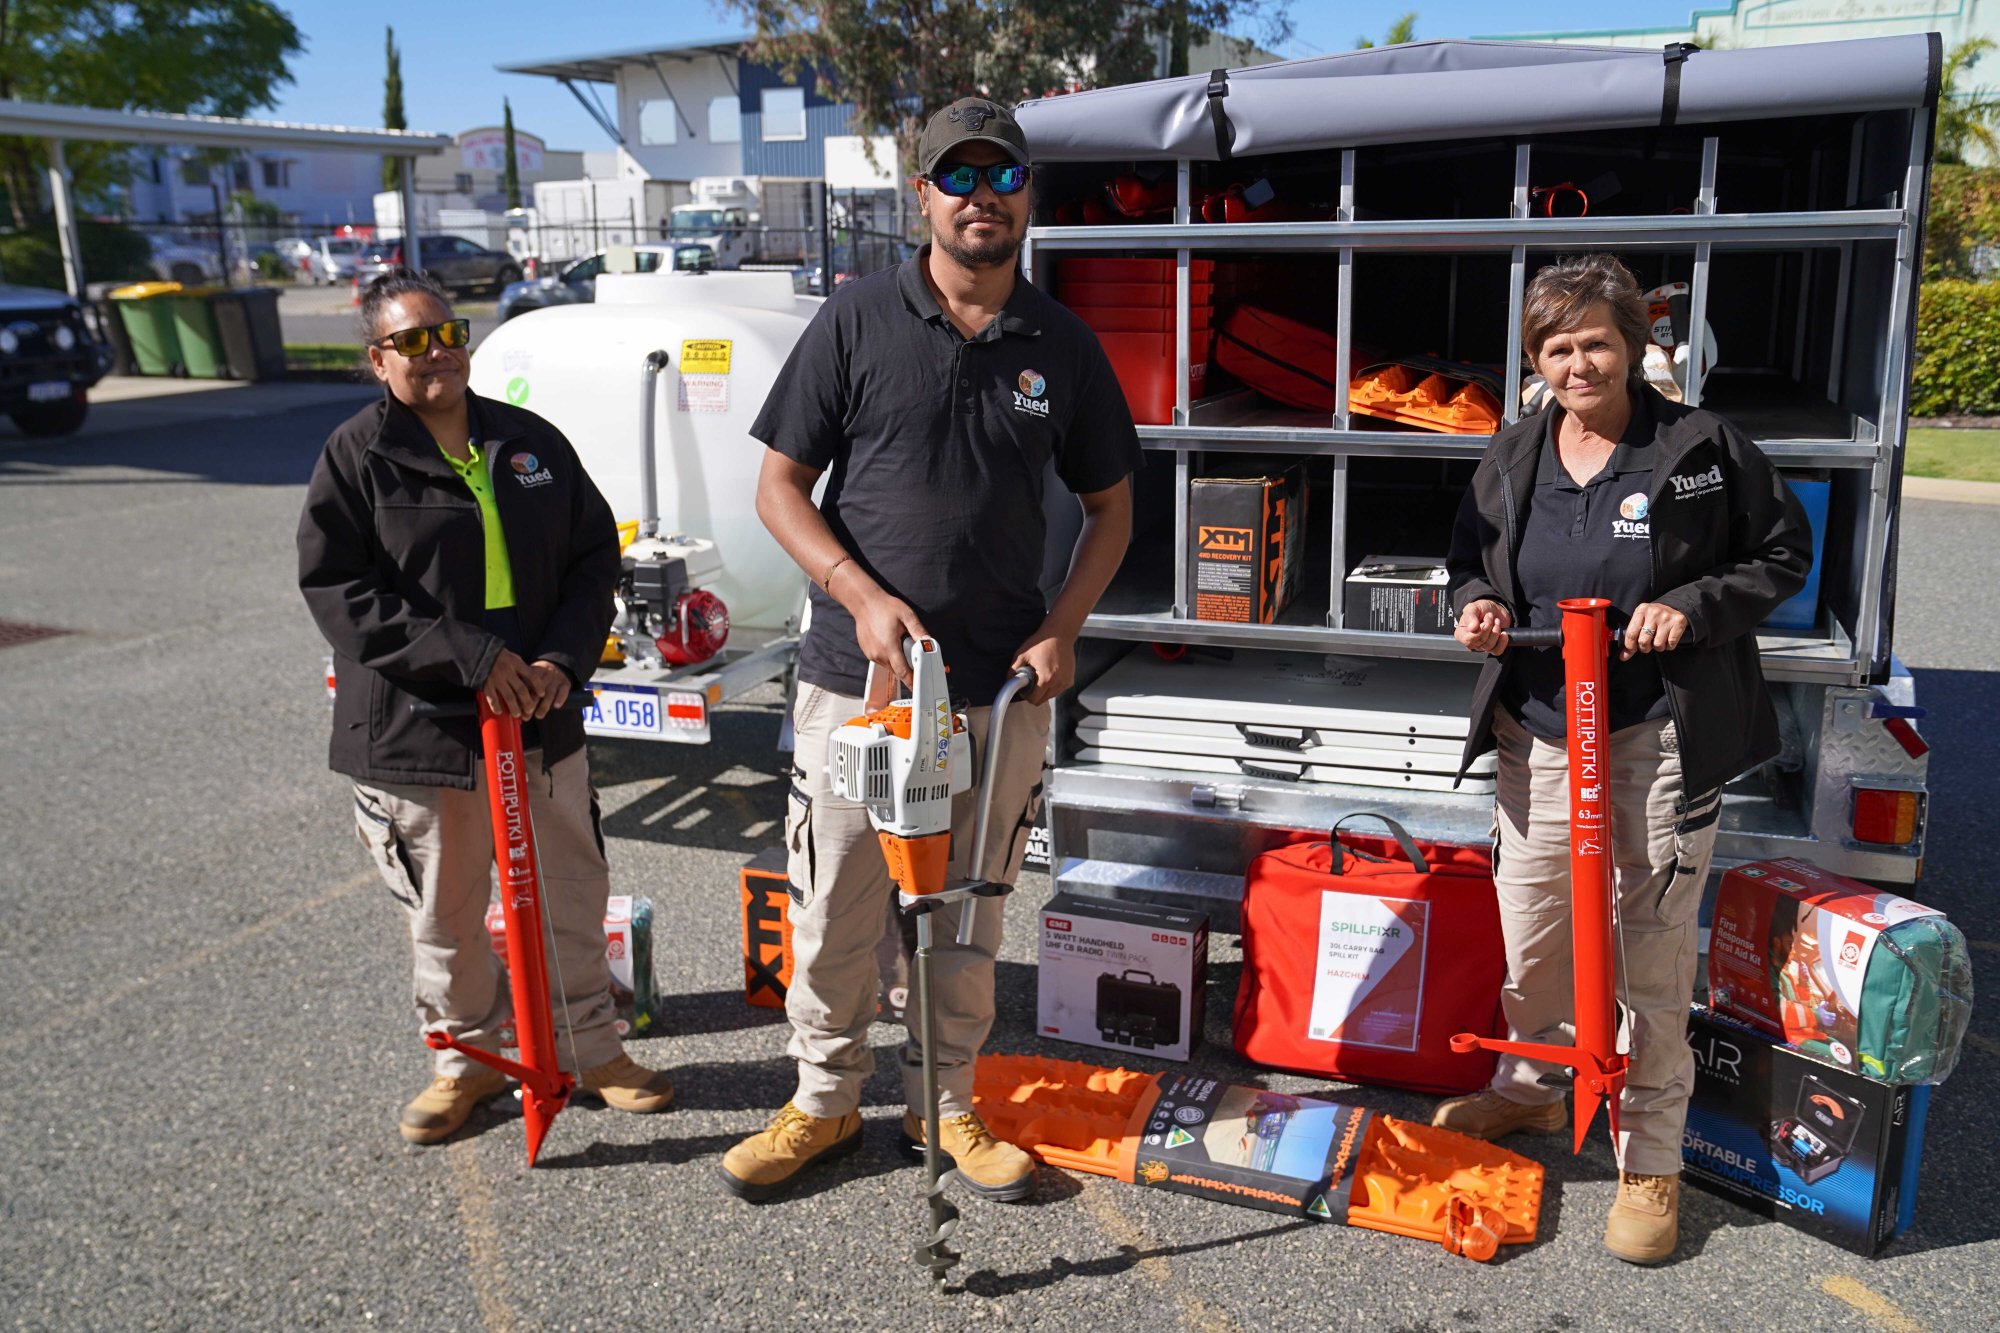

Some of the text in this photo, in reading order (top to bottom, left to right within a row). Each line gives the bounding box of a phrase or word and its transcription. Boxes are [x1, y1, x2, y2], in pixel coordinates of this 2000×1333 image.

[1012, 390, 1049, 414] Yued
[514, 468, 553, 485] Yued
[1668, 465, 1724, 493] Yued
[1199, 527, 1251, 551] XTM
[1211, 553, 1241, 561] RECOVERY
[1580, 681, 1597, 779] POTTIPUTKI
[500, 751, 522, 841] POTTIPUTKI
[1580, 788, 1598, 799] BCC
[1578, 809, 1603, 819] 63mm
[1048, 920, 1069, 930] GME
[1331, 921, 1400, 938] SPILLFIXR
[1719, 917, 1737, 932] First
[746, 875, 789, 1002] XTM
[1045, 931, 1125, 950] 5 WATT HANDHELD
[1343, 944, 1367, 952] CARRY
[1717, 927, 1755, 951] Response
[1045, 941, 1062, 950] UHF
[1064, 943, 1074, 951] CB
[1077, 945, 1104, 956] RADIO
[1106, 950, 1127, 960] TWIN
[1128, 953, 1149, 963] PACK
[1329, 951, 1346, 959] SPILL
[1715, 938, 1761, 965] First Aid Kit
[1327, 969, 1370, 981] HAZCHEM
[1681, 1133, 1758, 1174] ORTABLE
[1187, 1174, 1283, 1204] MAXTRAX
[1697, 1153, 1825, 1216] COMPRESSOR
